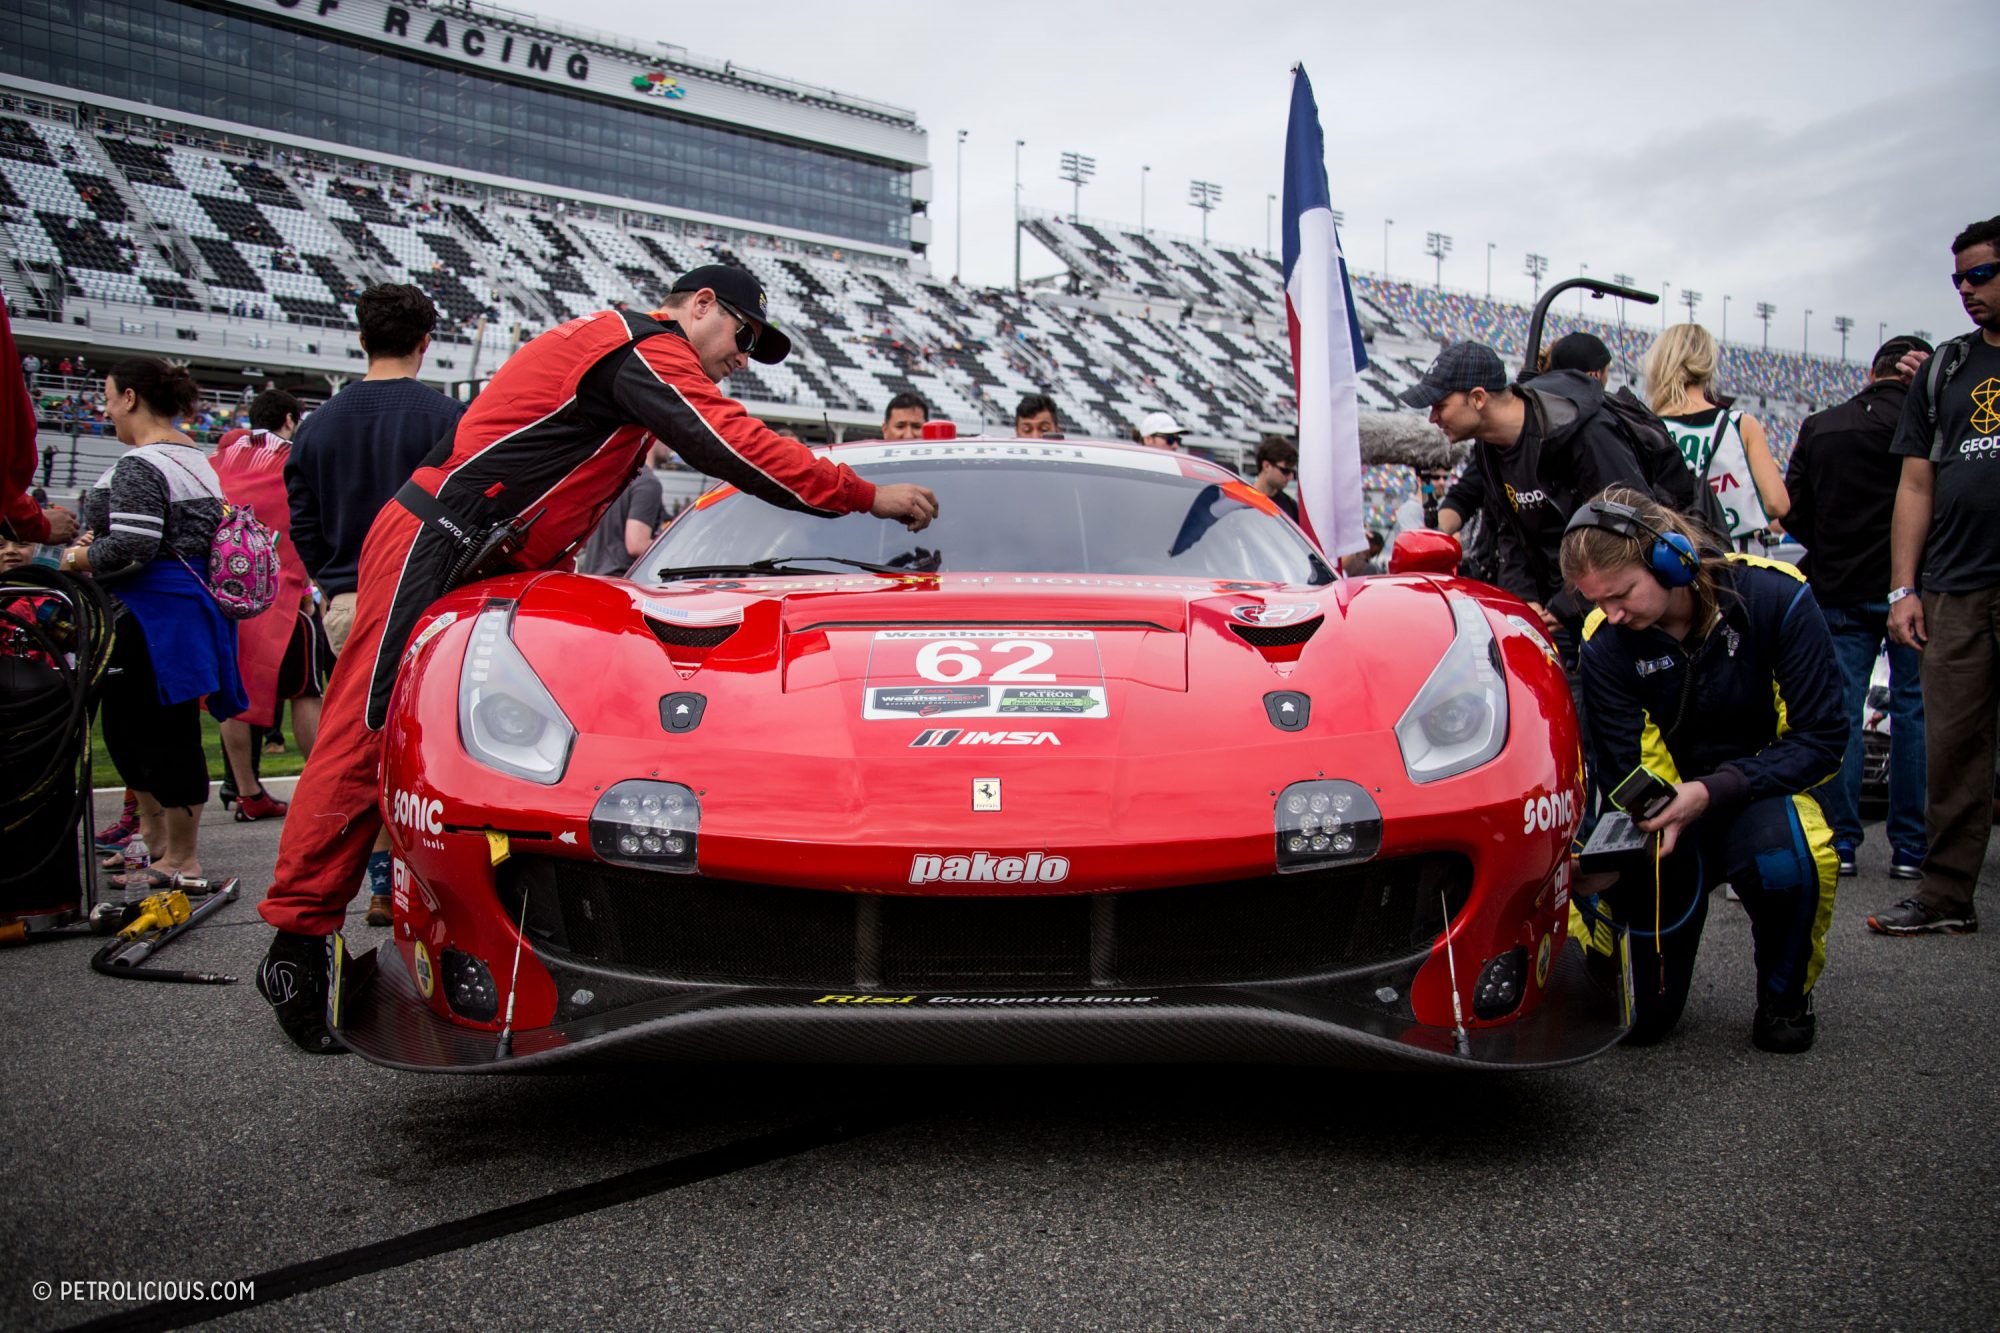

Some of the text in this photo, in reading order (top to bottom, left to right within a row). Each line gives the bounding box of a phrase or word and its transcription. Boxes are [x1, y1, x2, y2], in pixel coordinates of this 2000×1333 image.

[383, 5, 589, 82] RACING
[878, 447, 1086, 459] Ferrari
[1014, 576, 1212, 592] HOUSTON
[915, 639, 1057, 683] 62
[958, 731, 1062, 746] IMSA
[422, 837, 445, 850] tools
[908, 851, 1070, 885] pakelo
[812, 994, 1154, 1005] Risi Competizione
